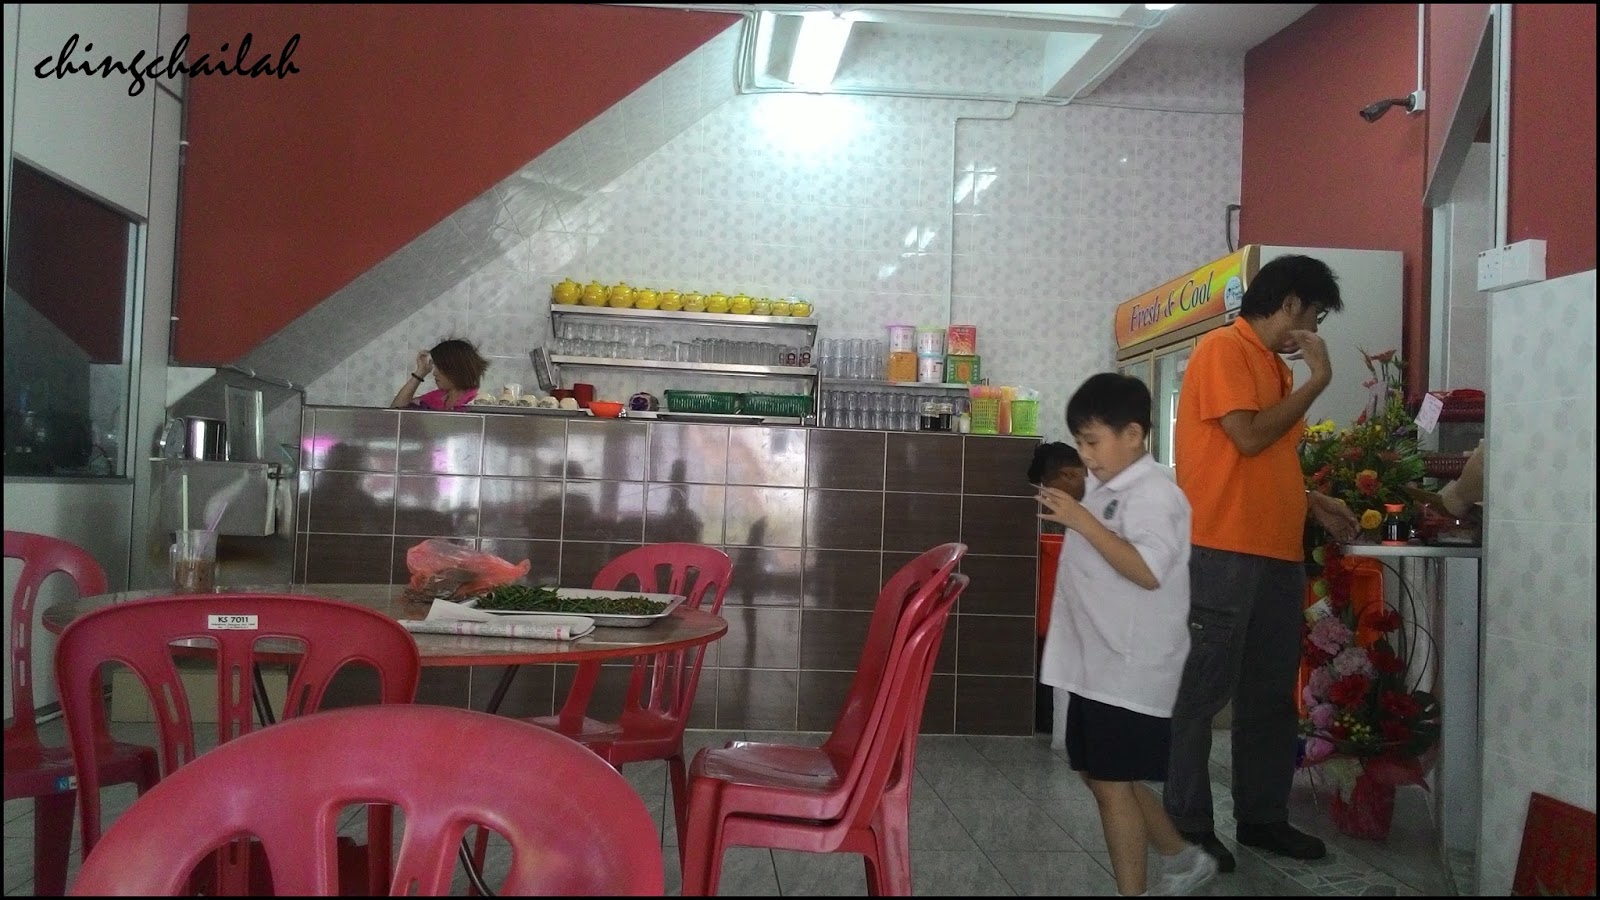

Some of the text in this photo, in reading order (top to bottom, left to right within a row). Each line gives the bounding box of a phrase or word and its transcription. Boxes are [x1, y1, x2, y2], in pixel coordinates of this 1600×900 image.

[1129, 295, 1161, 333] Fresh
[1164, 291, 1175, 318] &
[1179, 271, 1215, 312] Cool
